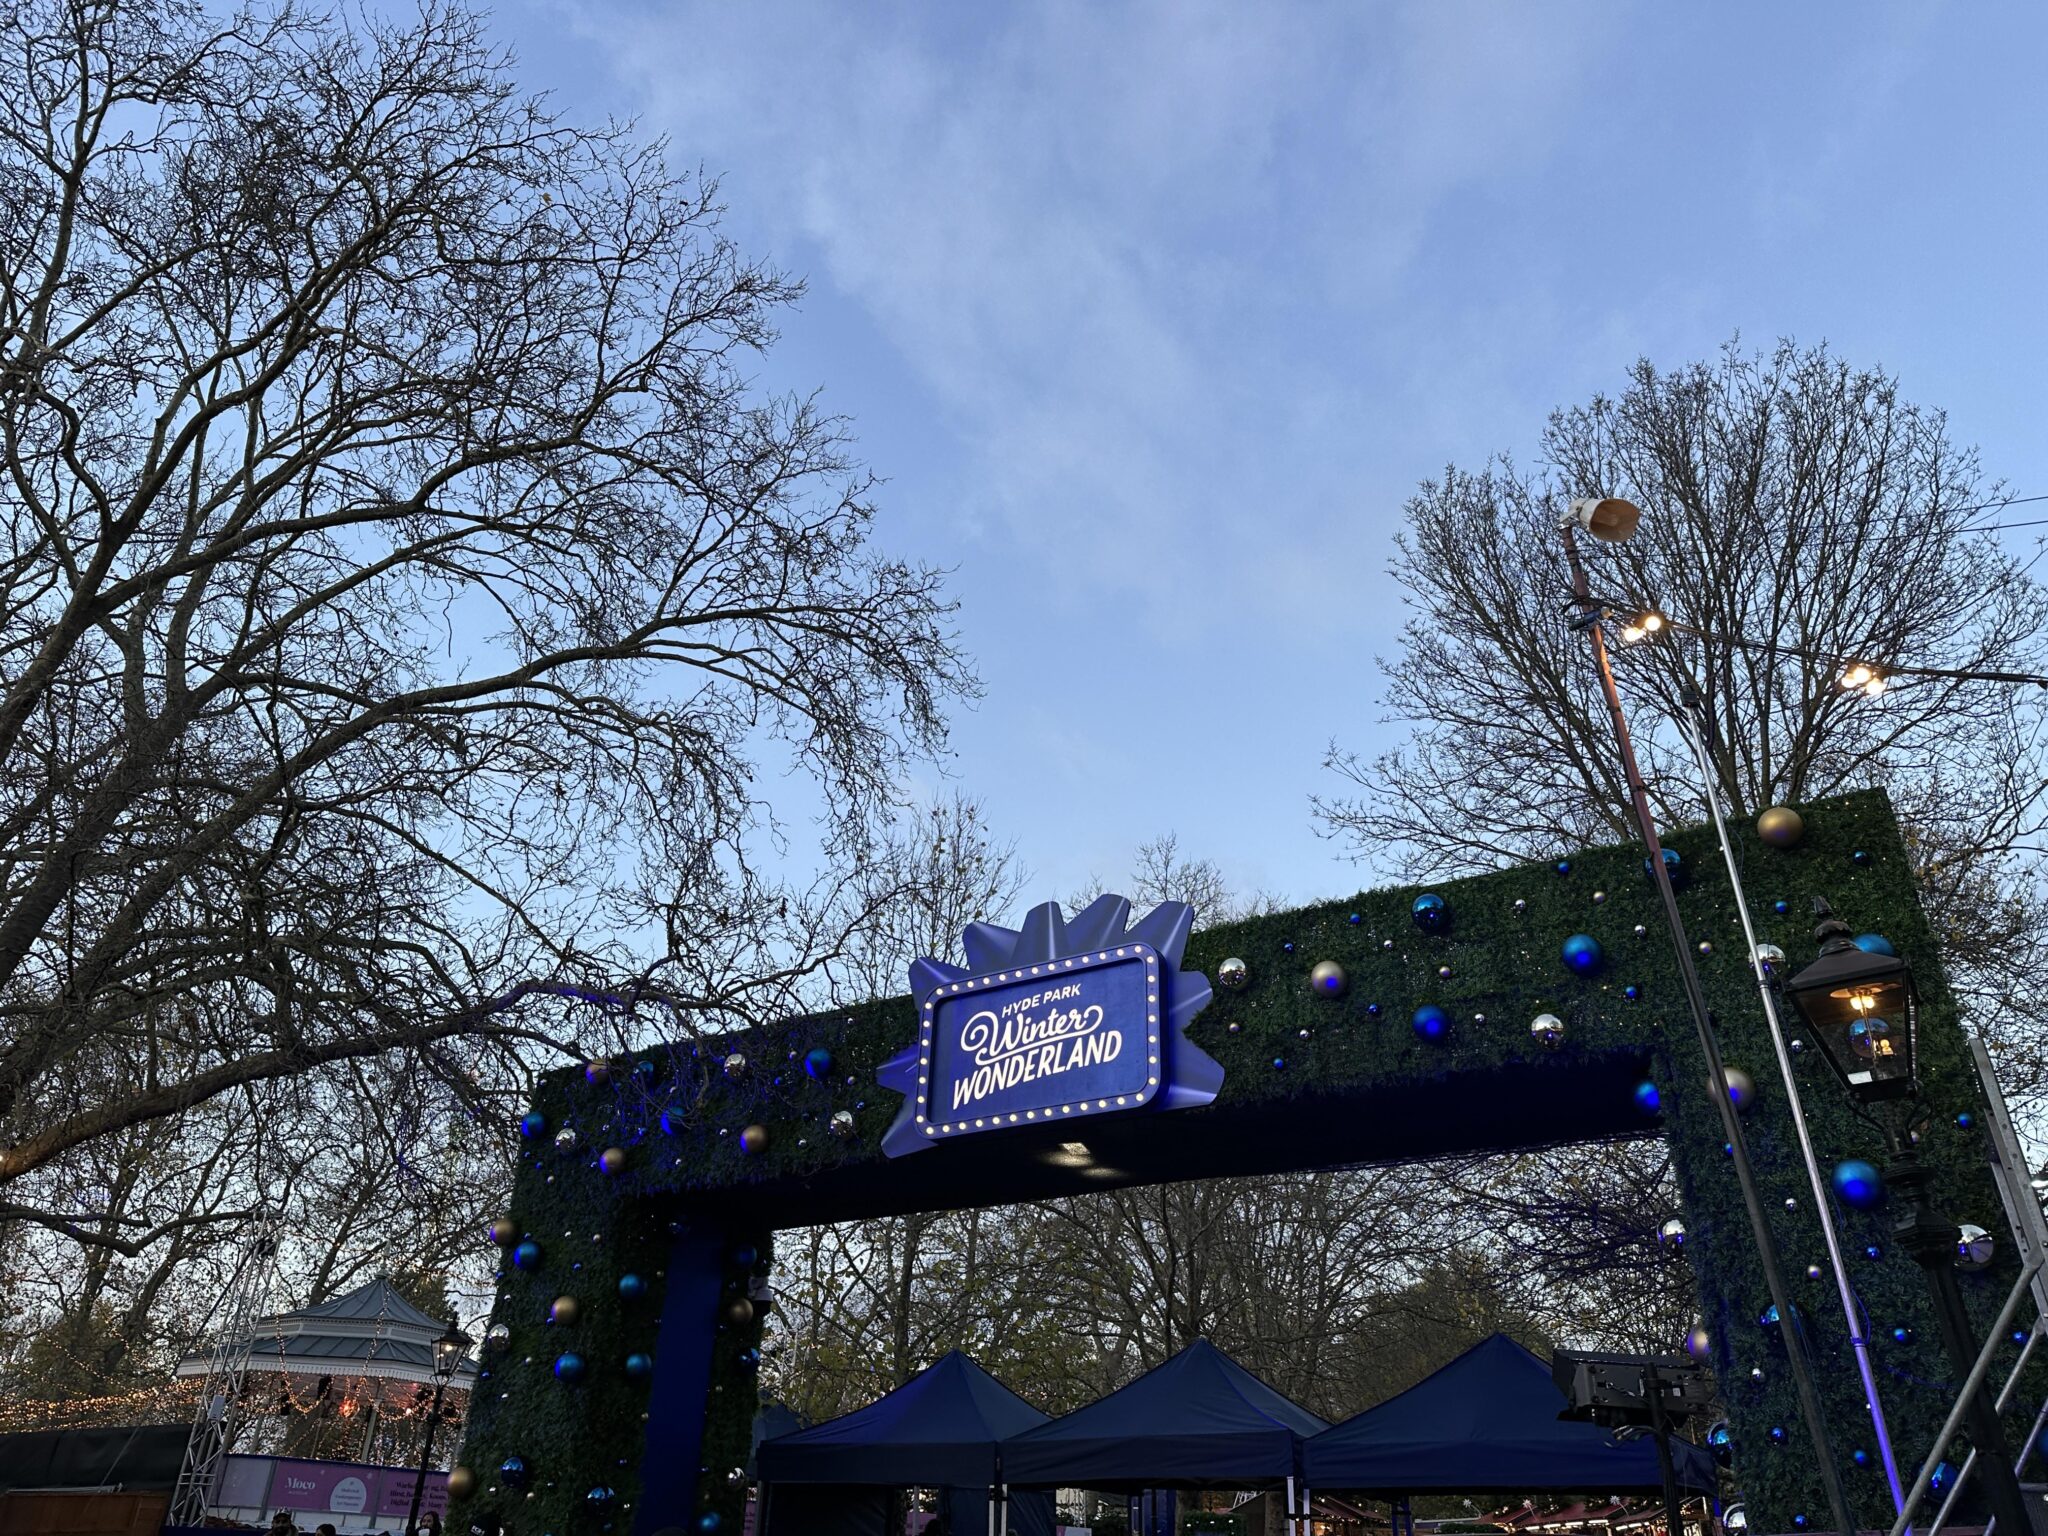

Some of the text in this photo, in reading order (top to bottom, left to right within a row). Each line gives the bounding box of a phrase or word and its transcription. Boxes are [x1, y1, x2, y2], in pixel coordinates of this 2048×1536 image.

[1001, 983, 1082, 1018] HYDE PARK
[960, 1004, 1104, 1066] Winter
[952, 1030, 1123, 1110] WONDERLAND
[284, 1476, 316, 1490] Moco
